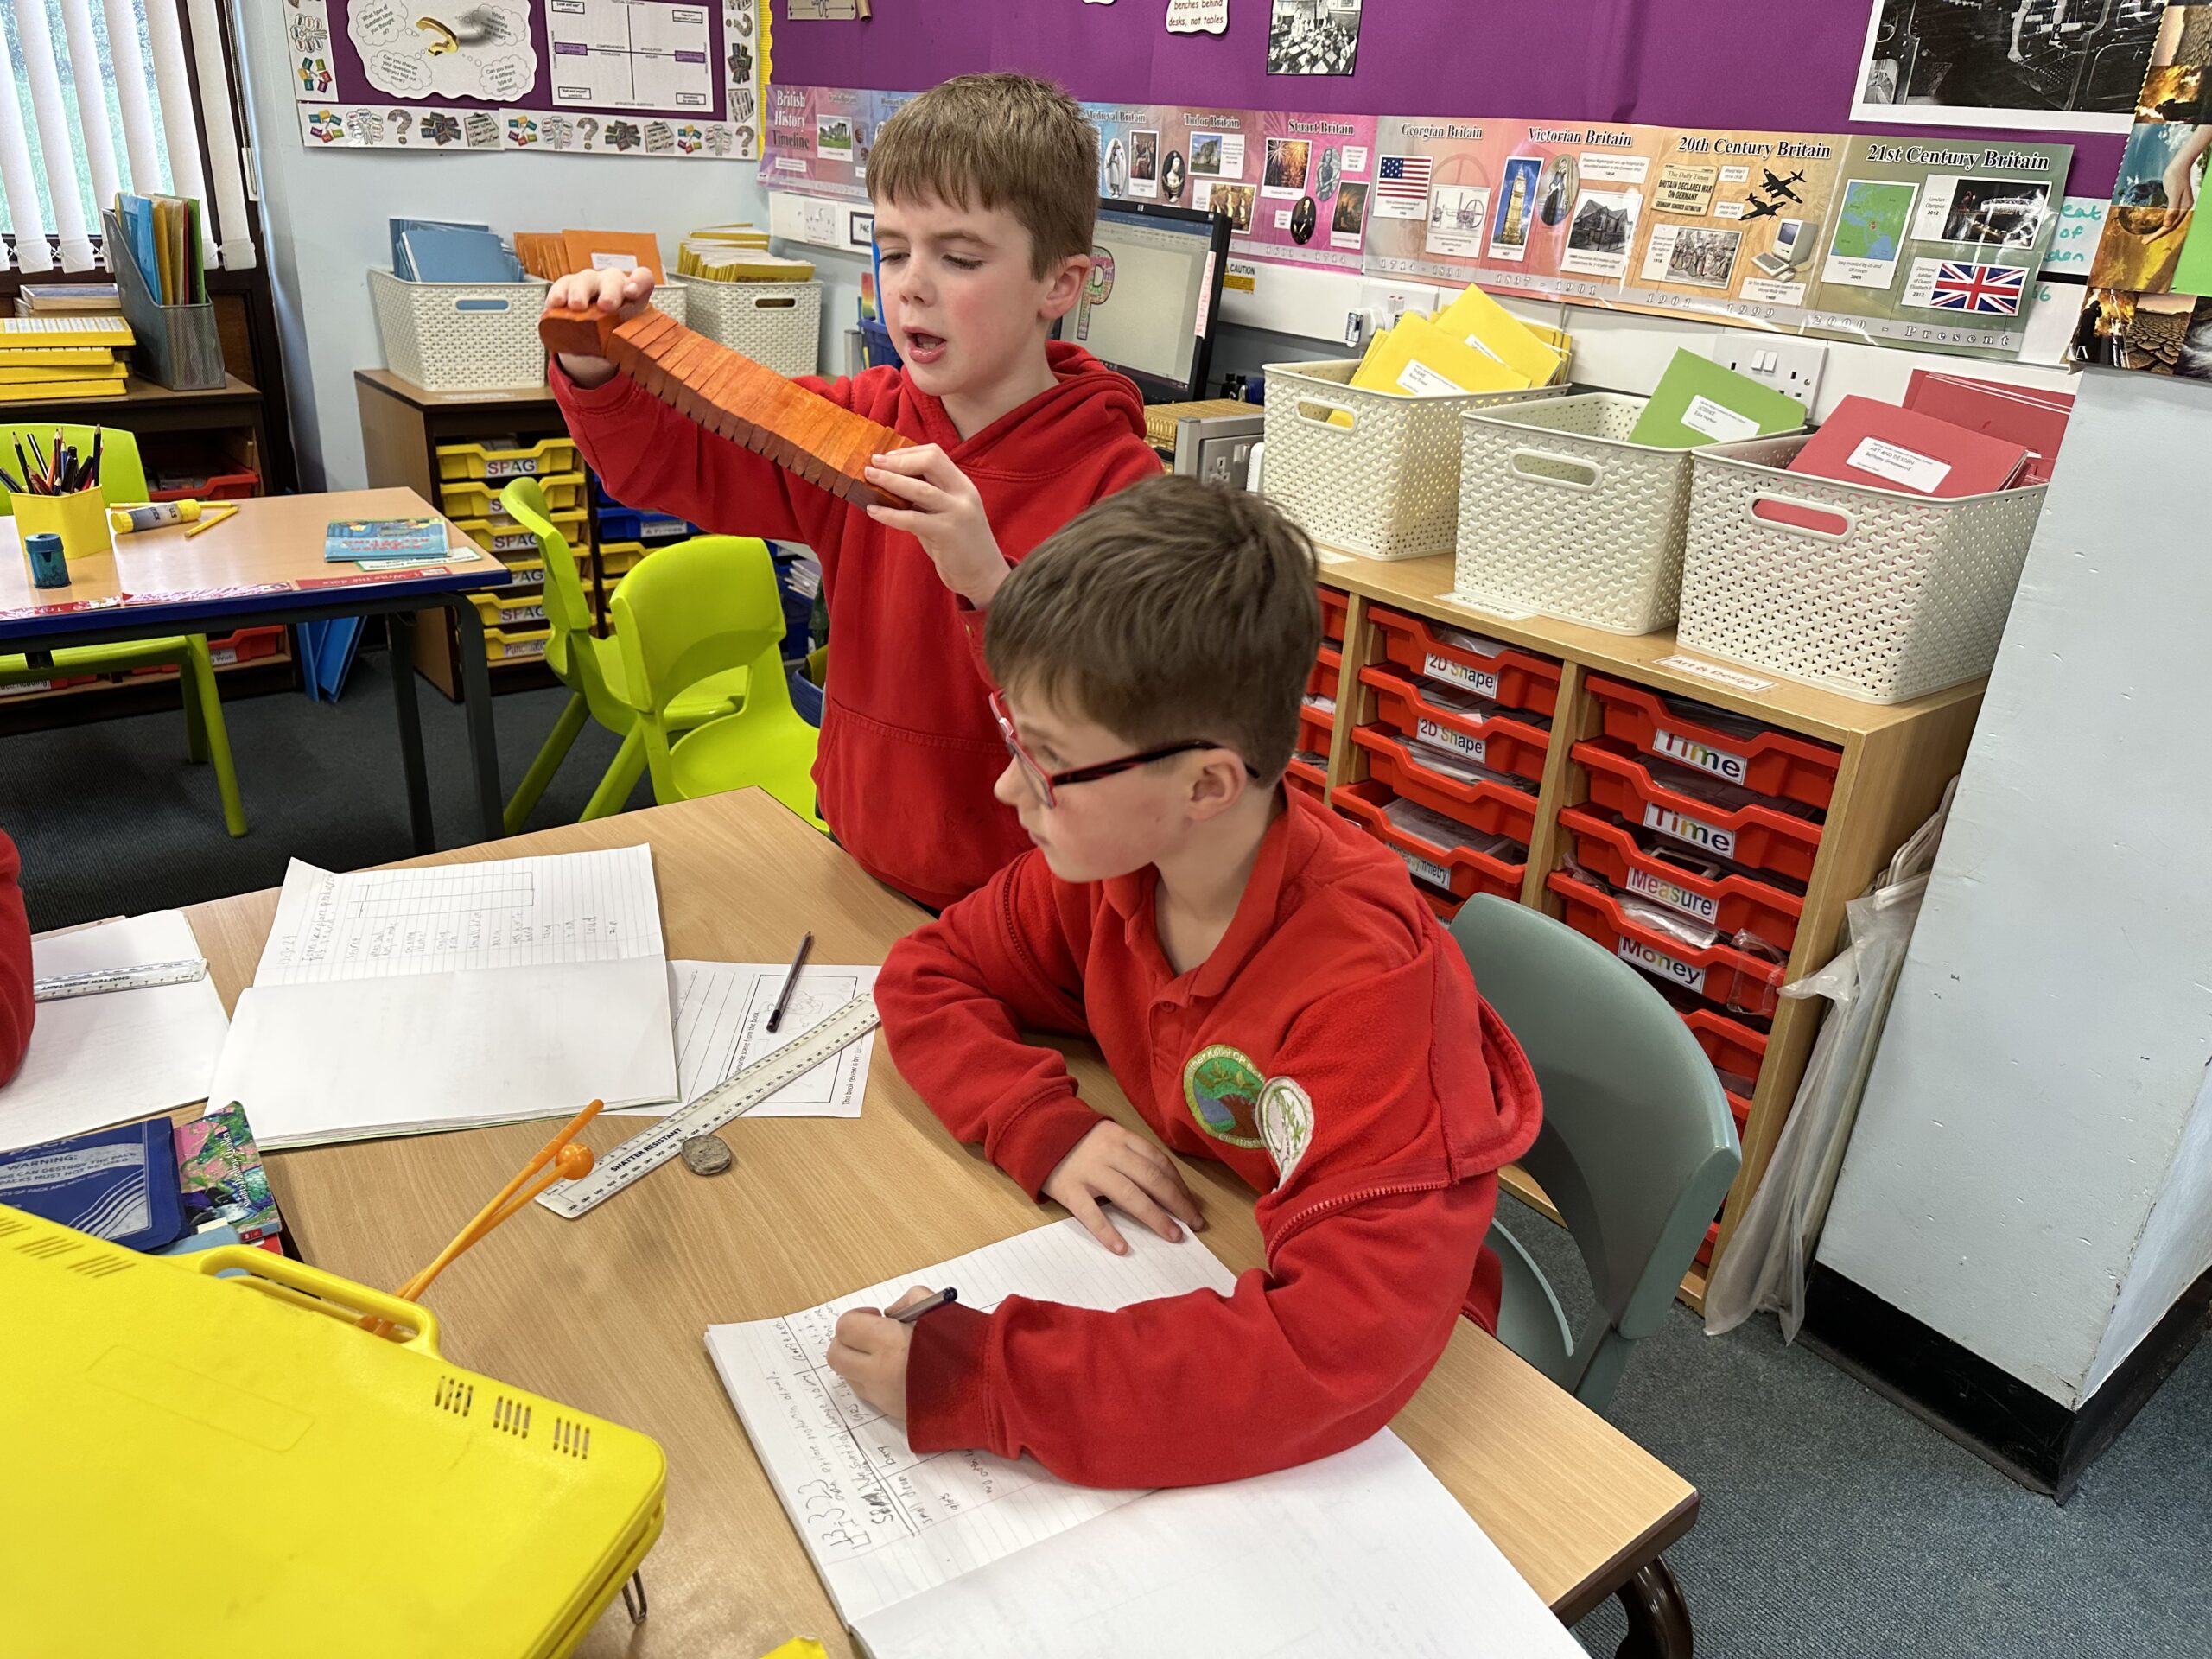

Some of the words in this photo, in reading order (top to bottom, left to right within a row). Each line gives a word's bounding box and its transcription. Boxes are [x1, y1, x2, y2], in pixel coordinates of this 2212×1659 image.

[1174, 0, 1199, 10] benches
[1168, 17, 1187, 28] desks,
[1190, 16, 1202, 26] not
[777, 90, 805, 108] British
[774, 110, 805, 132] History
[1084, 109, 1118, 123] Medieval
[1120, 111, 1146, 124] Britain
[1184, 113, 1209, 127] Tudor
[1210, 115, 1240, 129] Britain
[1288, 119, 1319, 133] Stuart
[1320, 121, 1354, 136] Britain
[1402, 123, 1444, 140] Georgian
[1447, 124, 1483, 139] Britain
[772, 130, 810, 149] Timeline
[1528, 127, 1580, 143] Victorian
[1586, 130, 1632, 146] Britain
[1678, 137, 1709, 153] 20th
[1713, 138, 1773, 159] Century
[1777, 141, 1831, 158] Britain
[1866, 144, 1902, 162] 21st
[1906, 146, 1979, 170] Century
[1982, 149, 2050, 171] Britain
[1658, 179, 1678, 188] BRITAIN
[1678, 181, 1701, 192] DECLARES
[1702, 183, 1713, 193] WAR
[1675, 191, 1698, 201] GERMANY
[2060, 225, 2083, 240] of
[1230, 264, 1255, 275] CAUTION
[1496, 274, 1531, 286] 1837
[1555, 281, 1597, 296] 1901
[1646, 293, 1692, 308] 1901
[1726, 304, 1775, 319] 1999
[1814, 315, 1866, 331] 2000
[1905, 326, 2010, 346] Present
[487, 460, 536, 474] SPAG
[1893, 454, 1915, 466] DESIGN
[1457, 594, 1516, 616] Science
[1429, 653, 1447, 671] 2D
[1451, 661, 1494, 689] Shape
[1671, 658, 1695, 671] Art
[1711, 670, 1759, 688] Design
[1420, 720, 1438, 737] 2D
[1441, 727, 1484, 754] Shape
[1666, 733, 1741, 778] Time
[1654, 805, 1730, 852] Time
[1631, 870, 1713, 916] Measure
[1622, 938, 1701, 985] Money
[41, 981, 90, 991] RESISTANT
[92, 976, 130, 985] SHATTER
[1233, 1051, 1247, 1065] CP
[844, 1084, 854, 1096] book
[610, 1149, 645, 1173] SHATTER
[643, 1128, 683, 1153] RESISTANT
[7, 1154, 78, 1171] WARNING:
[17, 1169, 40, 1178] CAN
[41, 1162, 86, 1174] DESTROY
[35, 1173, 61, 1181] MUST
